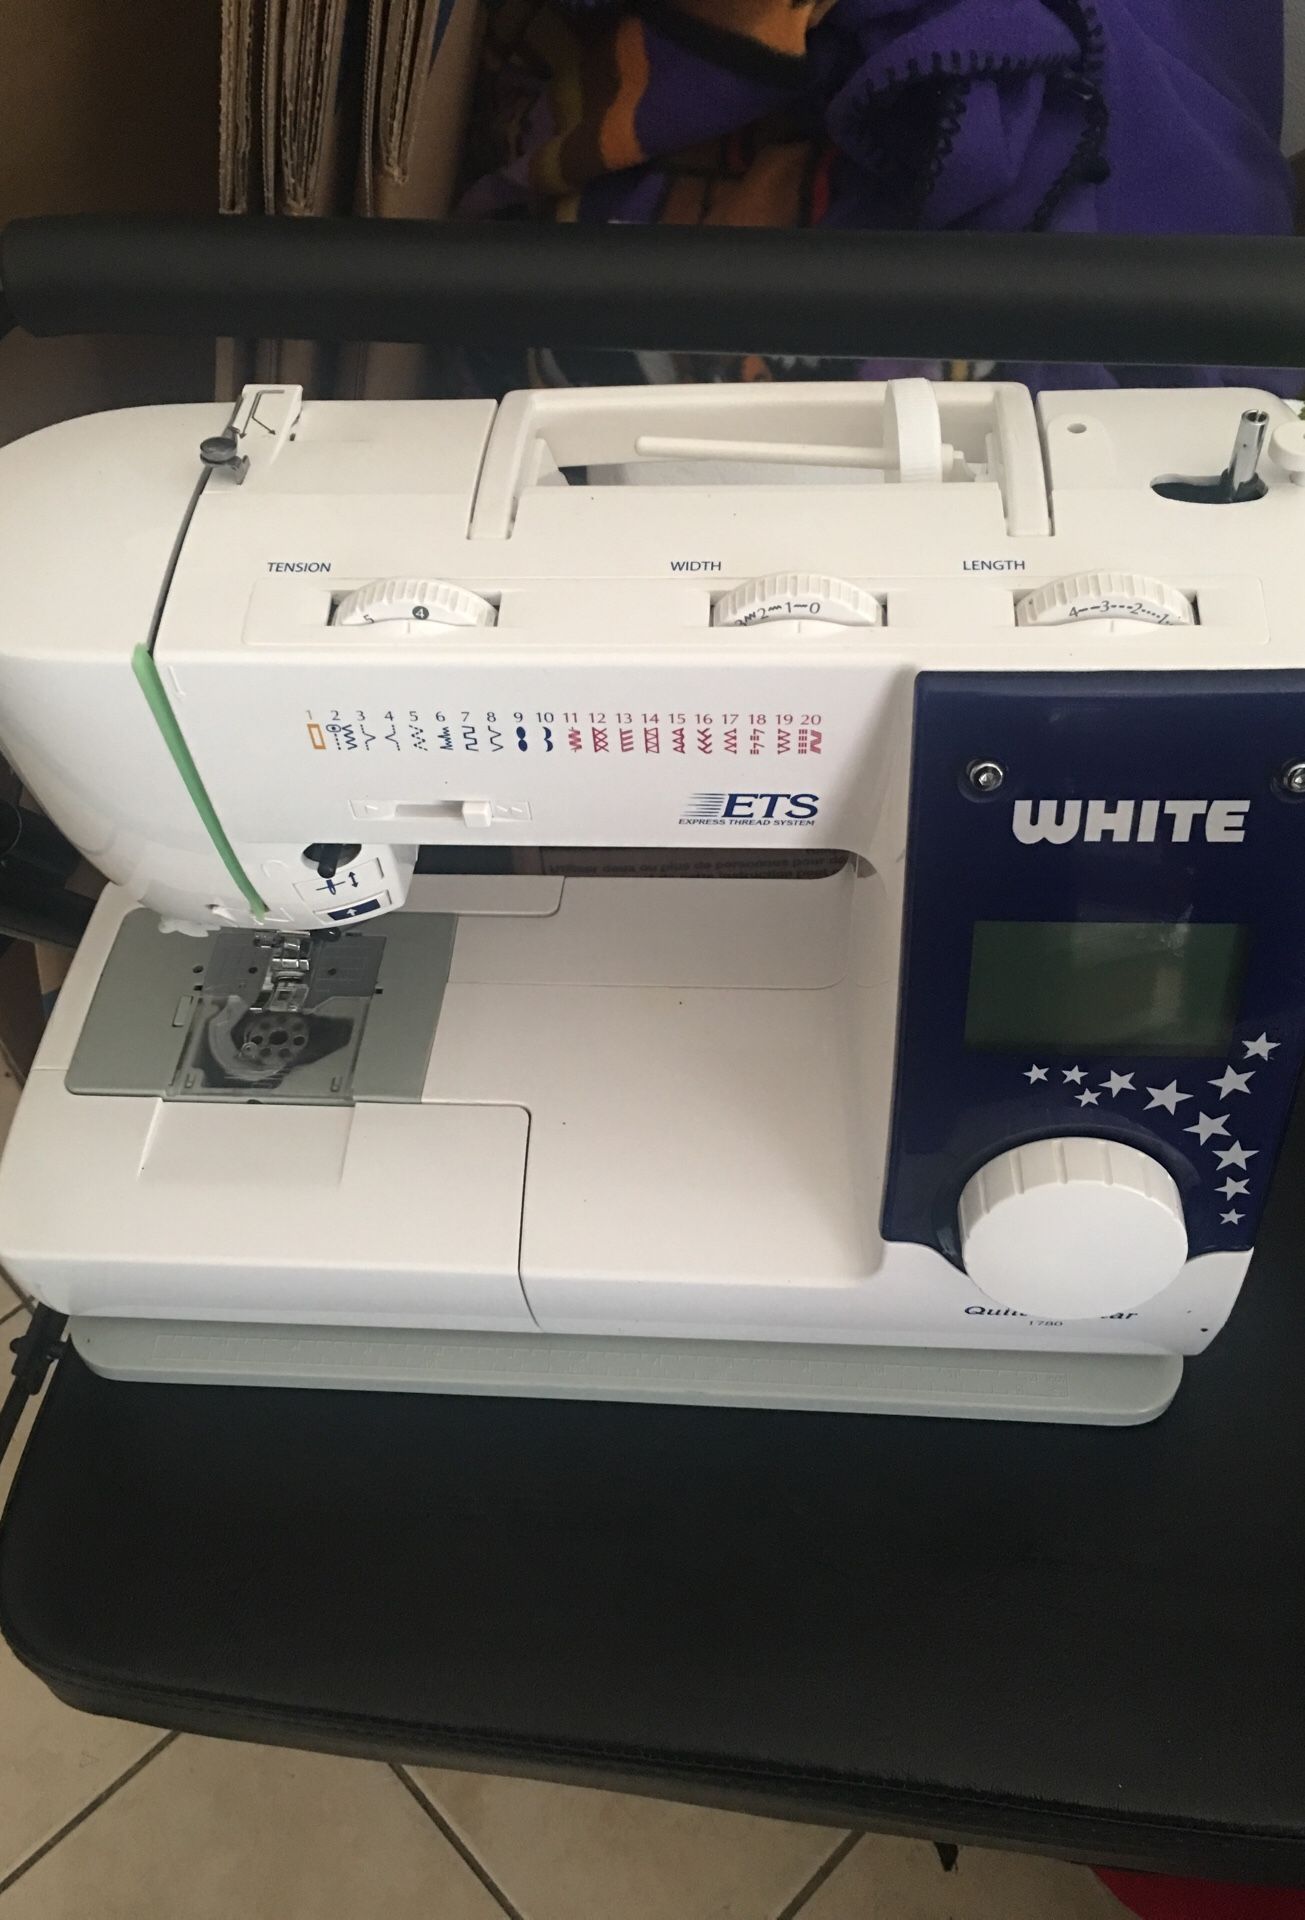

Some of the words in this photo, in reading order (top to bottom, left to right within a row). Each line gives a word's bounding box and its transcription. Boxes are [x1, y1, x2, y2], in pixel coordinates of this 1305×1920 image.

[268, 562, 332, 572] TENSION
[671, 561, 722, 571] WIDTH
[963, 559, 1026, 570] LENGTH
[414, 607, 426, 619] 4
[757, 607, 769, 620] 2
[809, 602, 821, 614] 0
[1069, 606, 1079, 617] 4
[1100, 600, 1110, 612] 3
[1130, 602, 1143, 615] 2
[306, 710, 312, 720] 1
[331, 711, 340, 720] 2
[357, 711, 365, 720] 3
[384, 711, 393, 721] 4
[410, 711, 418, 721] 5
[436, 712, 445, 721] 6
[461, 712, 469, 722] 7
[487, 712, 496, 722] 8
[514, 713, 523, 722] 9
[537, 712, 554, 722] 10
[564, 713, 577, 723] 11
[590, 713, 606, 723] 12
[617, 713, 632, 723] 13
[643, 714, 659, 723] 14
[670, 714, 685, 724] 15
[696, 714, 712, 724] 16
[723, 714, 739, 724] 17
[750, 714, 766, 724] 18
[776, 715, 793, 724] 19
[801, 715, 821, 725] 20
[721, 793, 819, 819] ETS
[678, 818, 726, 826] EXPRESS
[728, 818, 771, 826] THREAD
[773, 819, 815, 827] SYSTEM
[1012, 800, 1250, 844] WHITE
[1029, 1319, 1064, 1327] 1780
